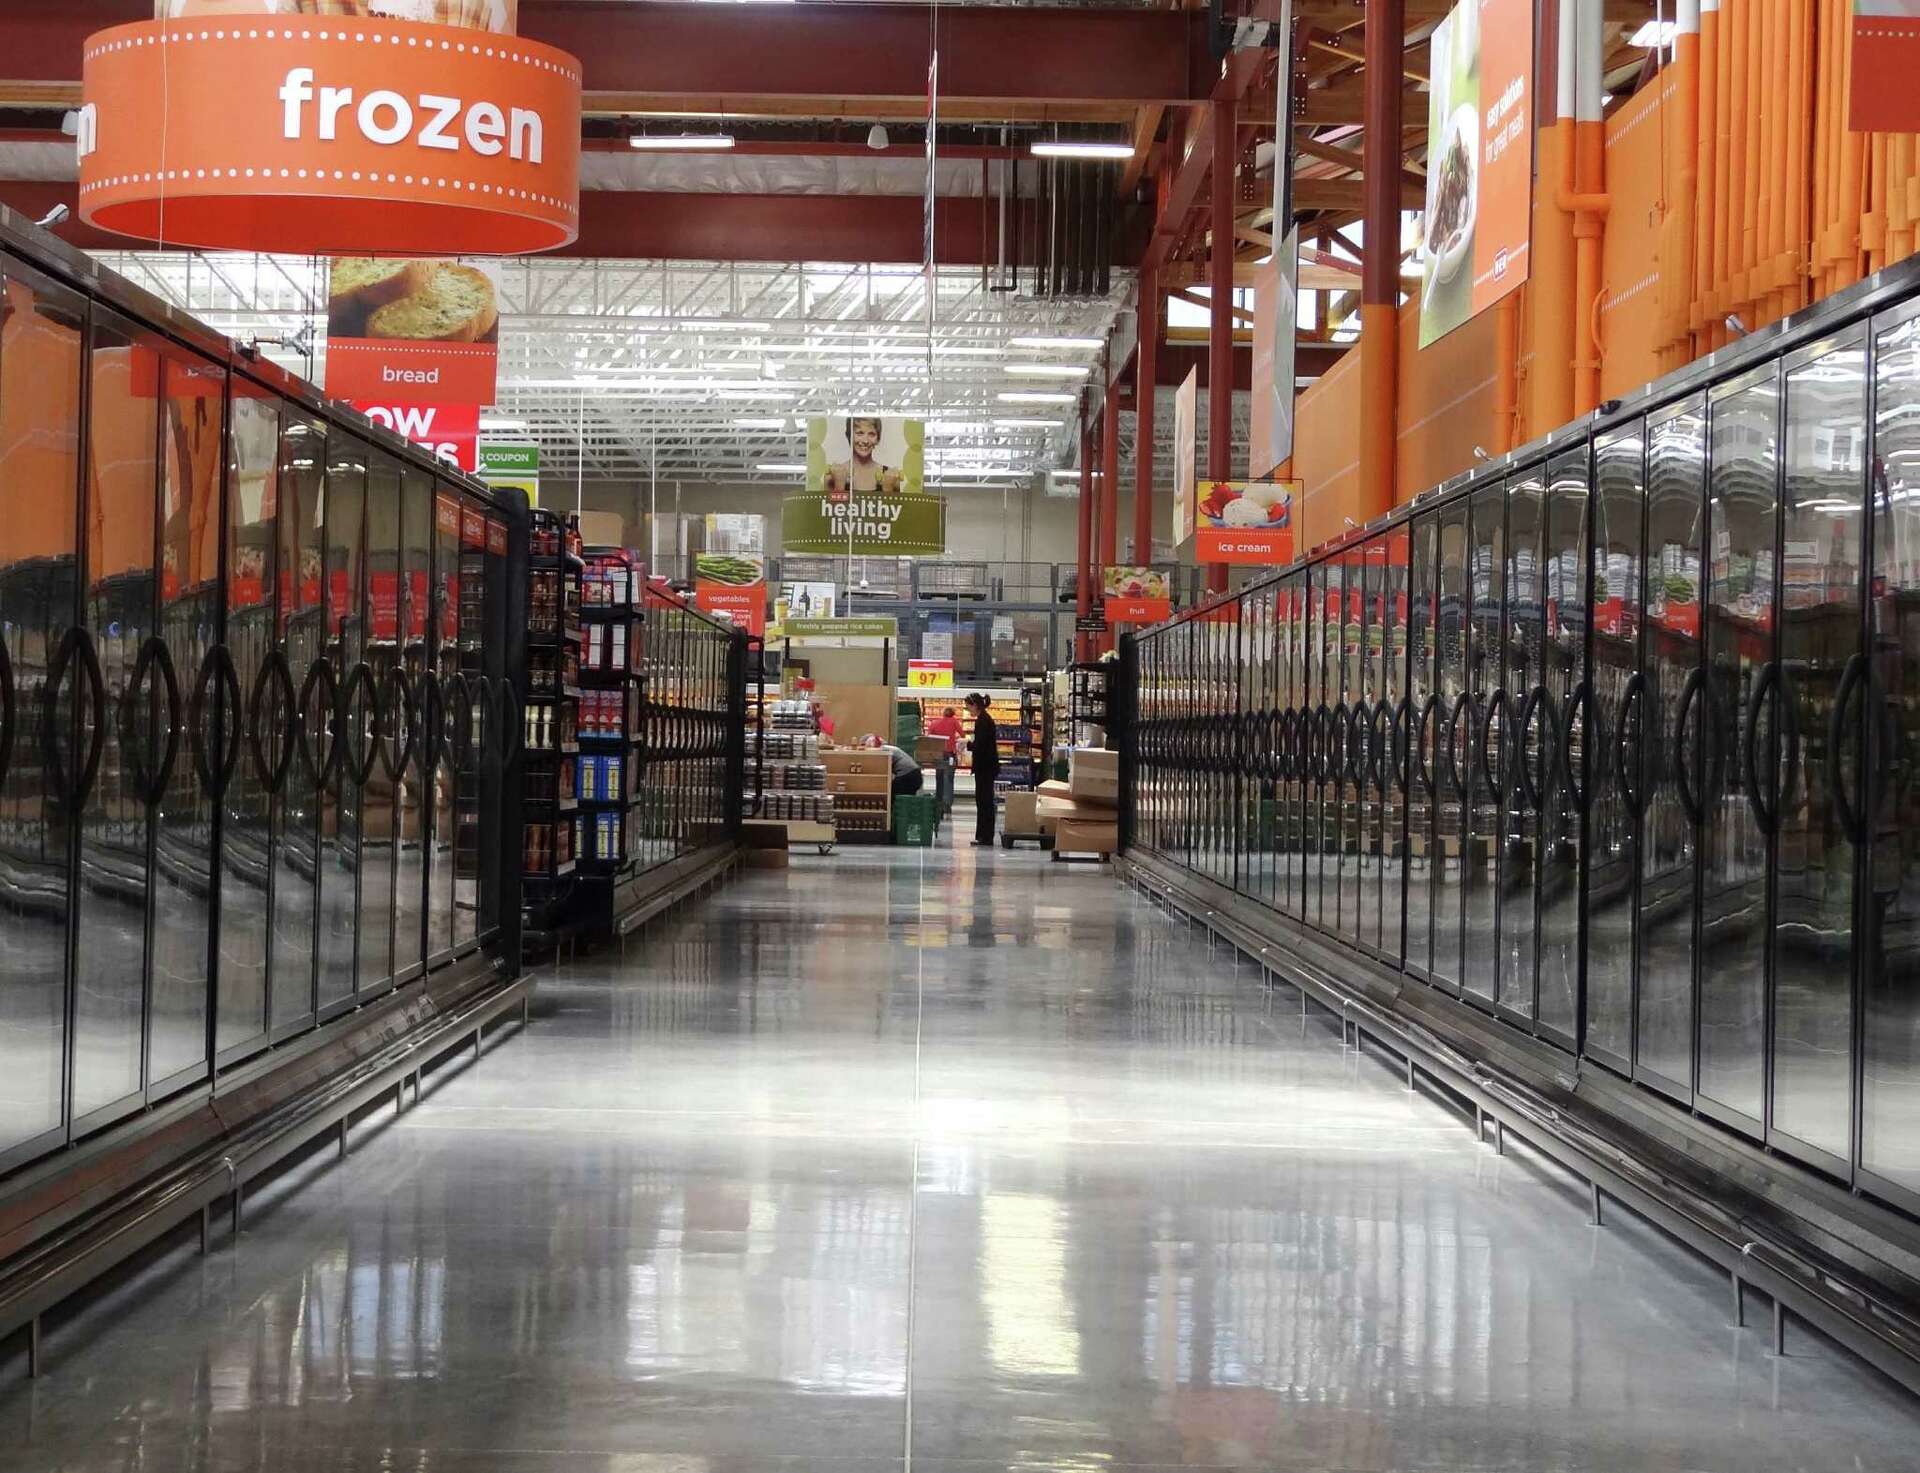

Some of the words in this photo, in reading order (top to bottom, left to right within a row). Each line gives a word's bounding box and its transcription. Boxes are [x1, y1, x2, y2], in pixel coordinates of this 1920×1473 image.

[279, 67, 542, 164] frozen
[383, 365, 439, 384] bread
[363, 406, 437, 438] OW
[486, 453, 529, 463] COUPON
[821, 499, 902, 521] healthy
[831, 518, 891, 539] living
[1218, 542, 1233, 552] ice
[1237, 543, 1271, 553] cream
[708, 595, 750, 603] vegetables
[1129, 607, 1145, 615] fruit
